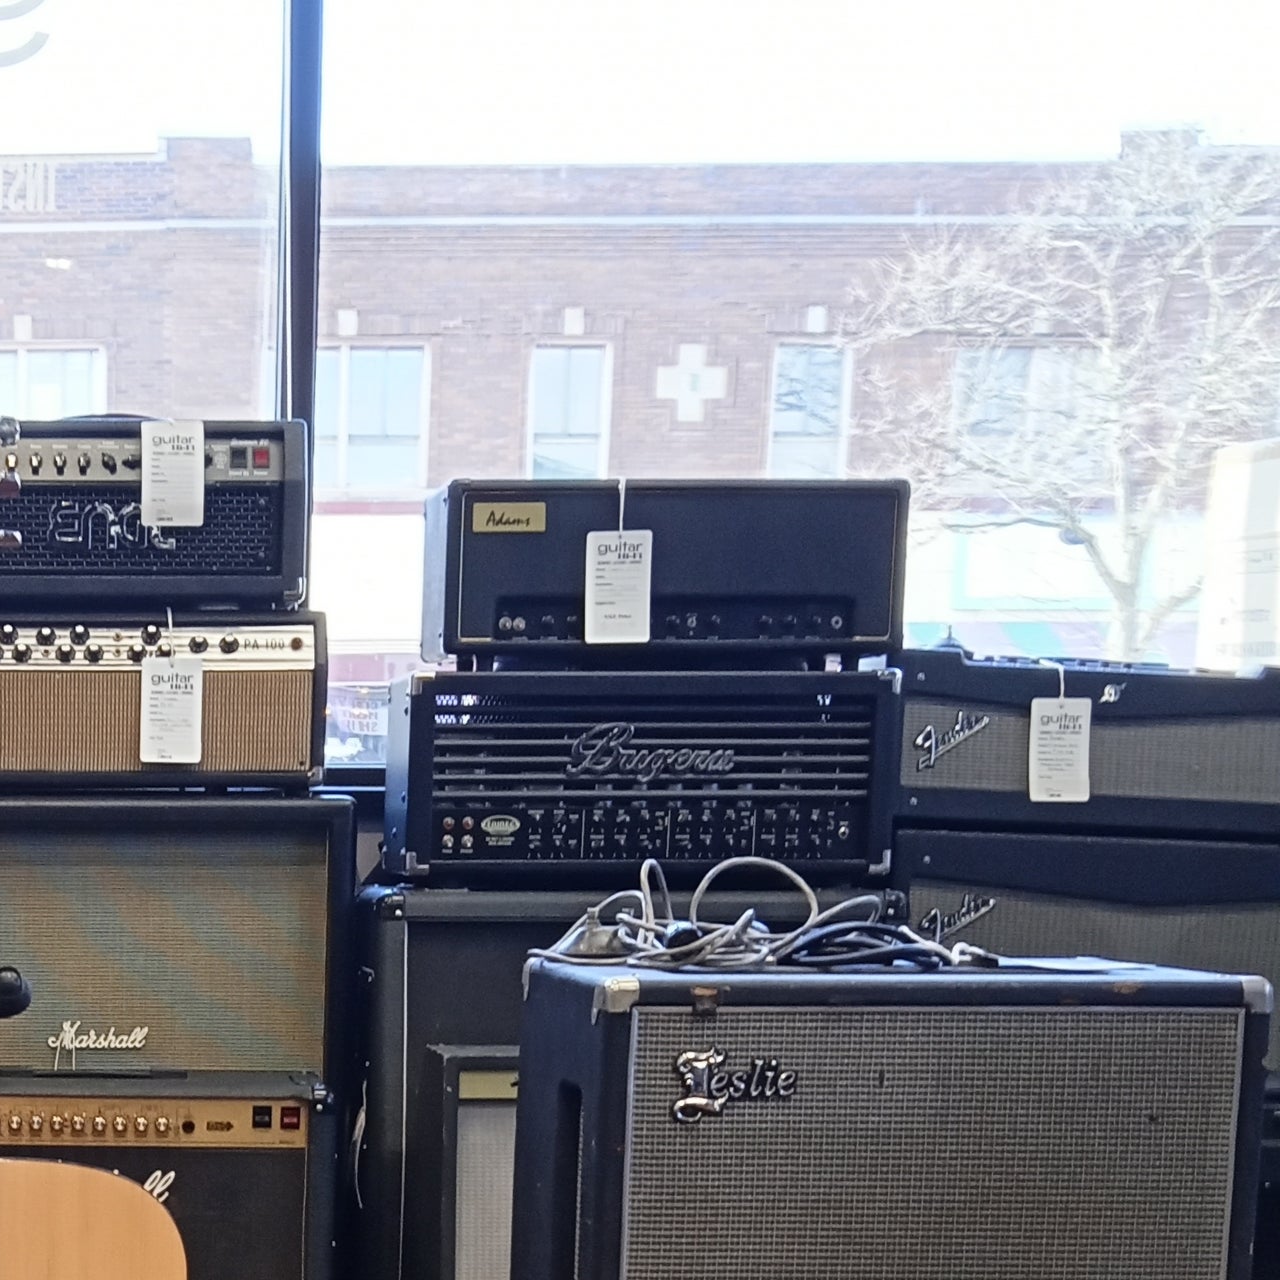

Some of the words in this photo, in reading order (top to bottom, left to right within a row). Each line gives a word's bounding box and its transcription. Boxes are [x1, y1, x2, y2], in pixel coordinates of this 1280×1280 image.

[151, 434, 195, 447] guitar
[597, 541, 643, 556] guitar
[243, 637, 259, 650] PA
[264, 637, 286, 650] 100
[150, 672, 195, 686] guitar
[1039, 712, 1083, 726] guitar
[913, 709, 990, 771] Fender
[47, 1019, 150, 1052] Marshall
[670, 1045, 799, 1124] Leslie
